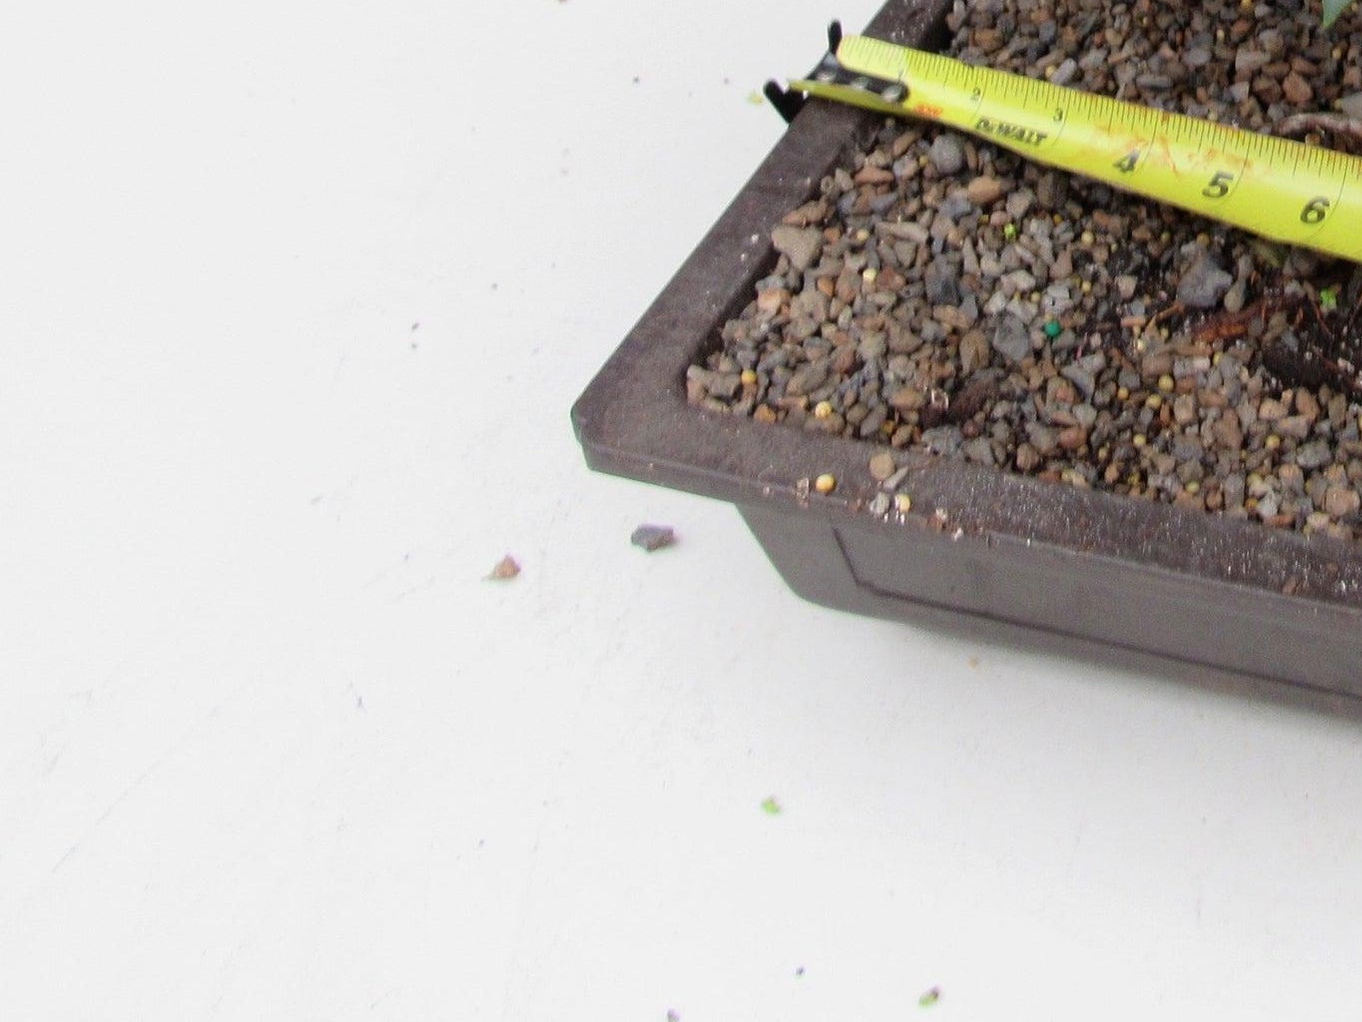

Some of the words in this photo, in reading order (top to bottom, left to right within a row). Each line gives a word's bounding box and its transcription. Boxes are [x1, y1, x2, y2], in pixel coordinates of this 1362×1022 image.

[971, 87, 981, 101] 2
[1053, 107, 1064, 122] 3
[1113, 149, 1140, 173] 4
[1202, 171, 1234, 198] 5
[1300, 196, 1330, 224] 6
